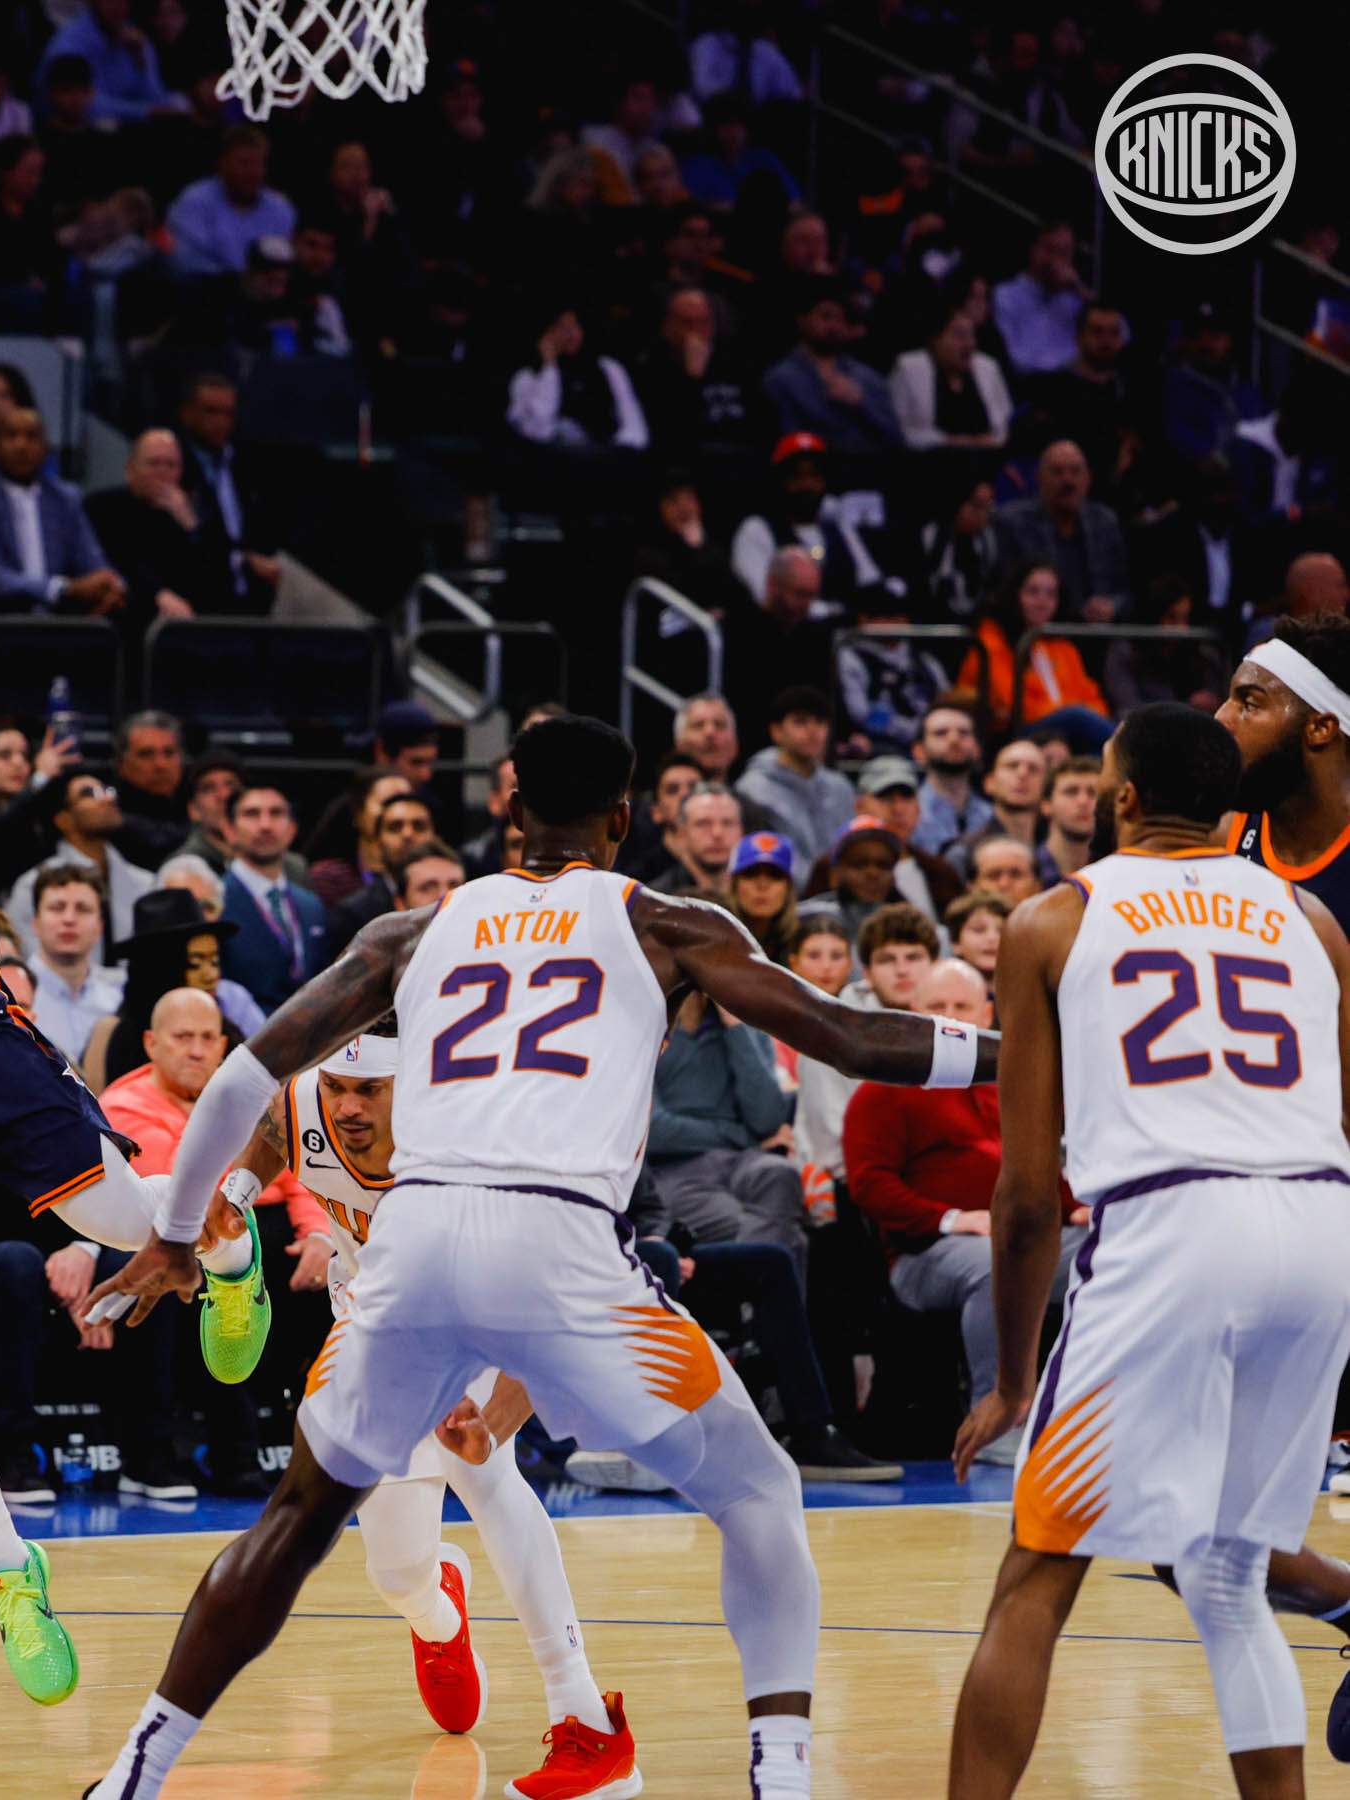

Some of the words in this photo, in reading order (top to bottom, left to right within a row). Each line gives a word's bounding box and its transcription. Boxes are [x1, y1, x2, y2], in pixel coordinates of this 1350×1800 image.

[1241, 828, 1257, 850] 6
[474, 909, 580, 950] AYTON
[1111, 889, 1286, 945] BRIDGES
[430, 957, 606, 1086] 22
[1111, 949, 1303, 1090] 25
[306, 1131, 321, 1151] 6
